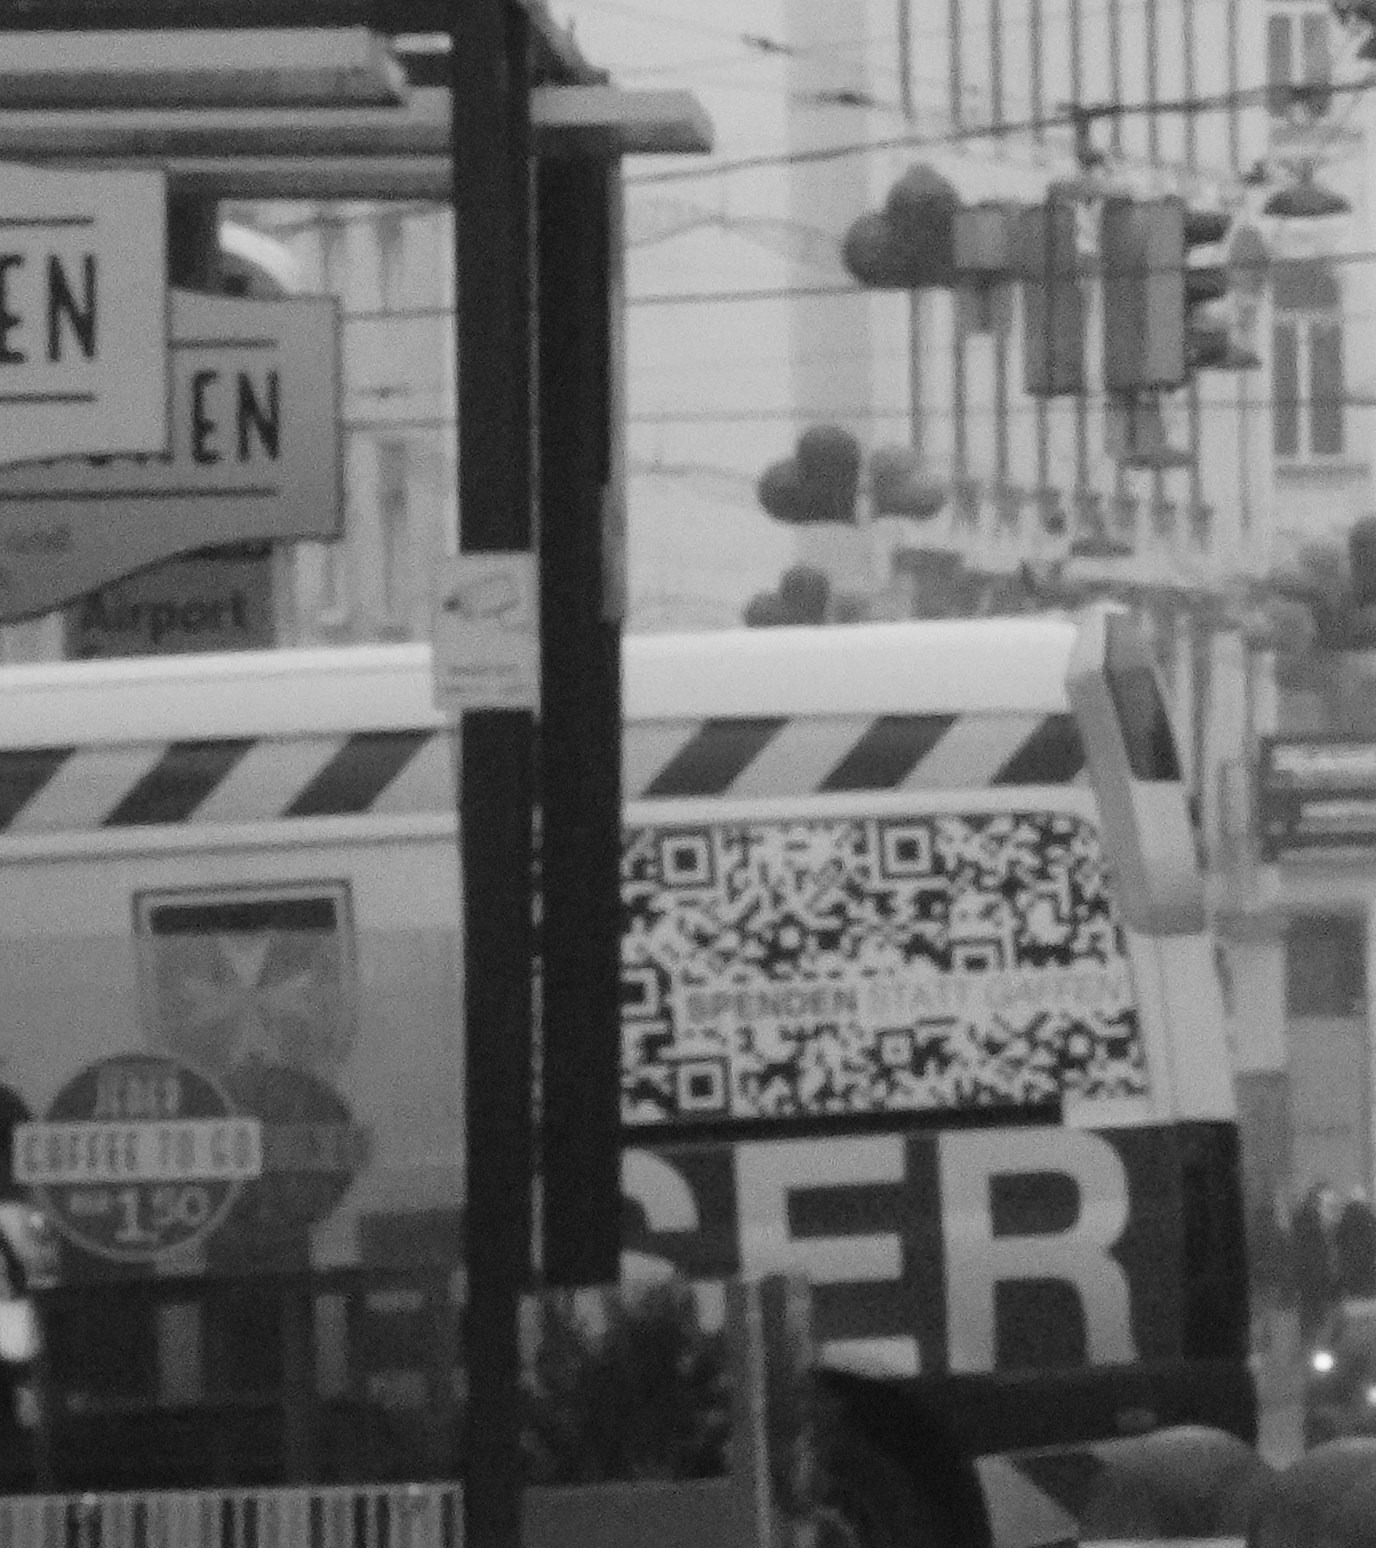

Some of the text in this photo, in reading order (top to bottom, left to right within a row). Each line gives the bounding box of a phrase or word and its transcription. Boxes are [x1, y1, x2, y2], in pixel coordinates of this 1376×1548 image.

[189, 369, 283, 467] EN
[685, 986, 858, 1023] SPENDEN
[866, 979, 974, 1017] STATT
[24, 1126, 252, 1174] COFFEE TO GO
